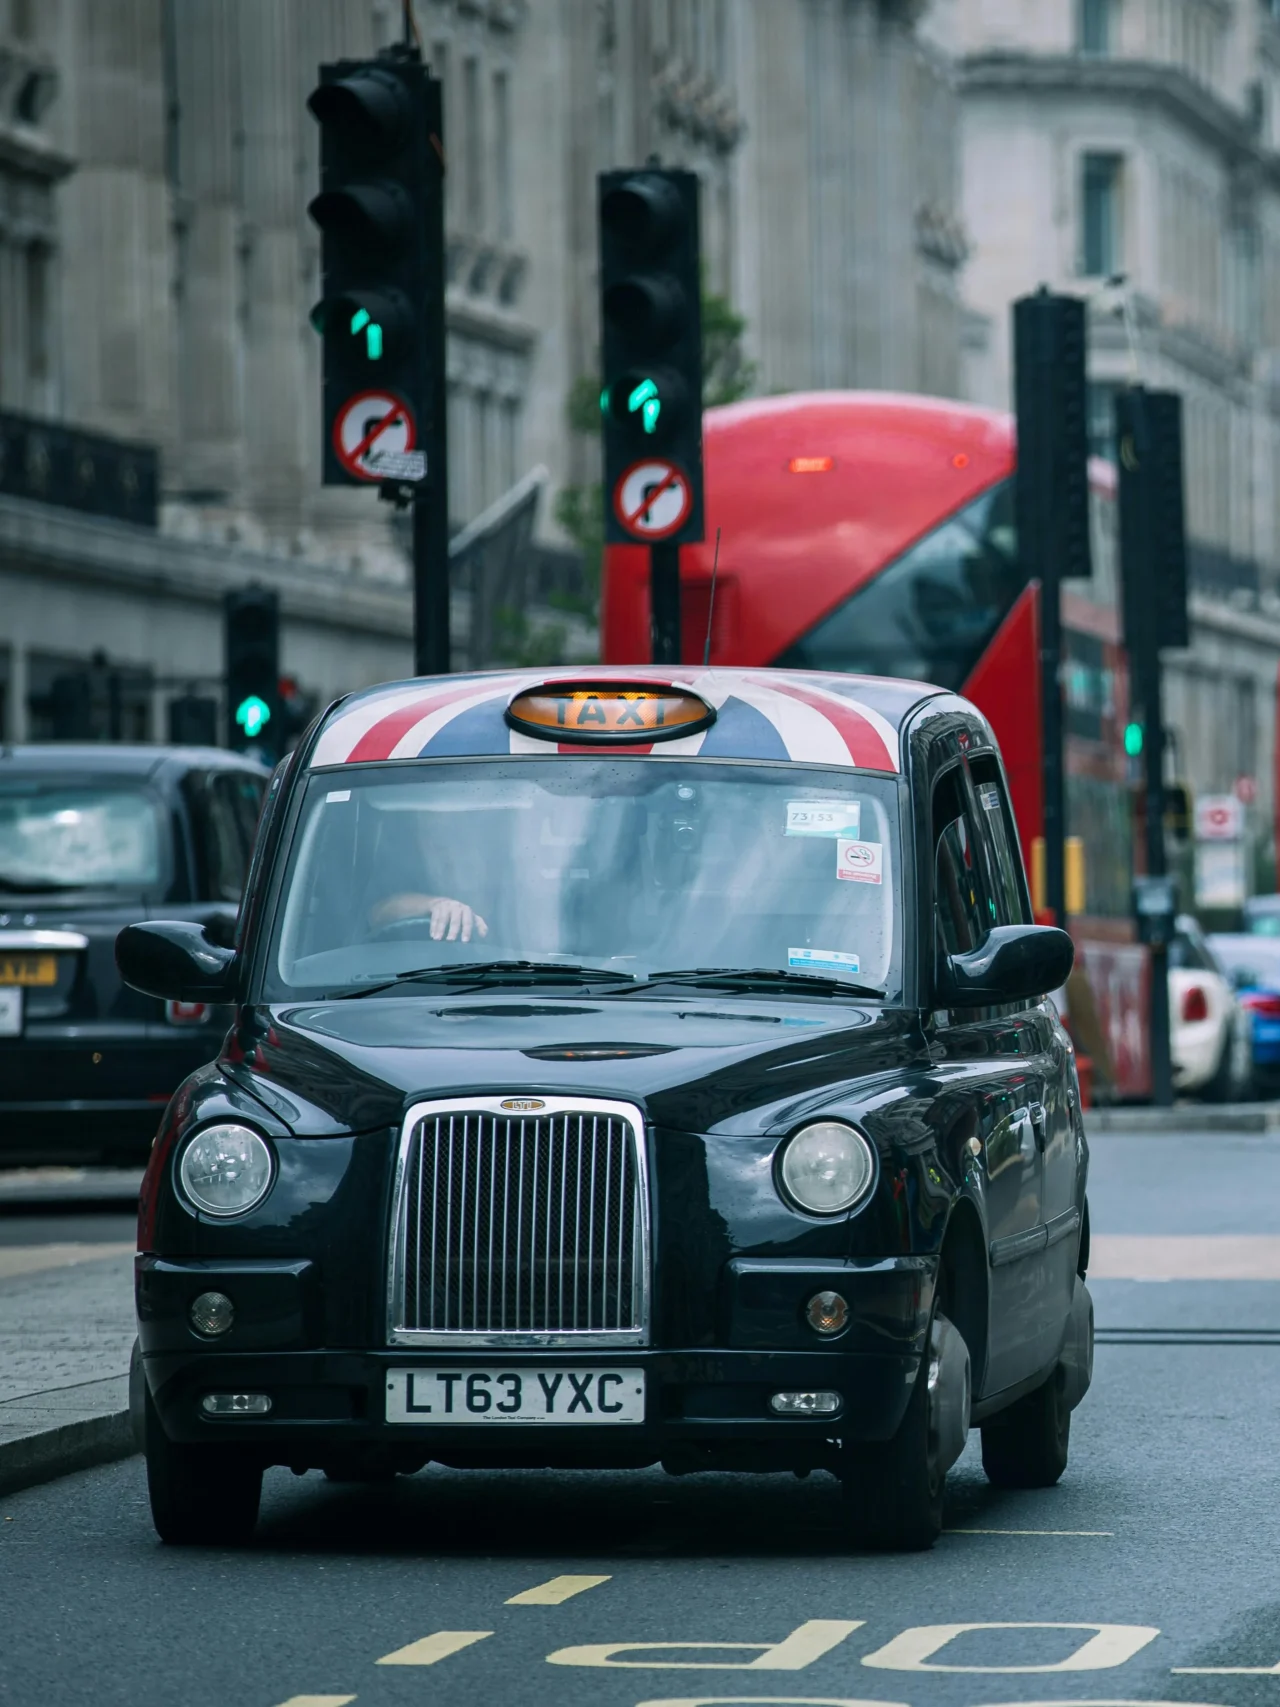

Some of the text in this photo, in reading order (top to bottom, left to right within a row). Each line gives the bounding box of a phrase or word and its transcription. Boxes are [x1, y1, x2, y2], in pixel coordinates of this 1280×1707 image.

[552, 695, 667, 726] TAXI
[405, 1373, 624, 1414] LT63 YXC
